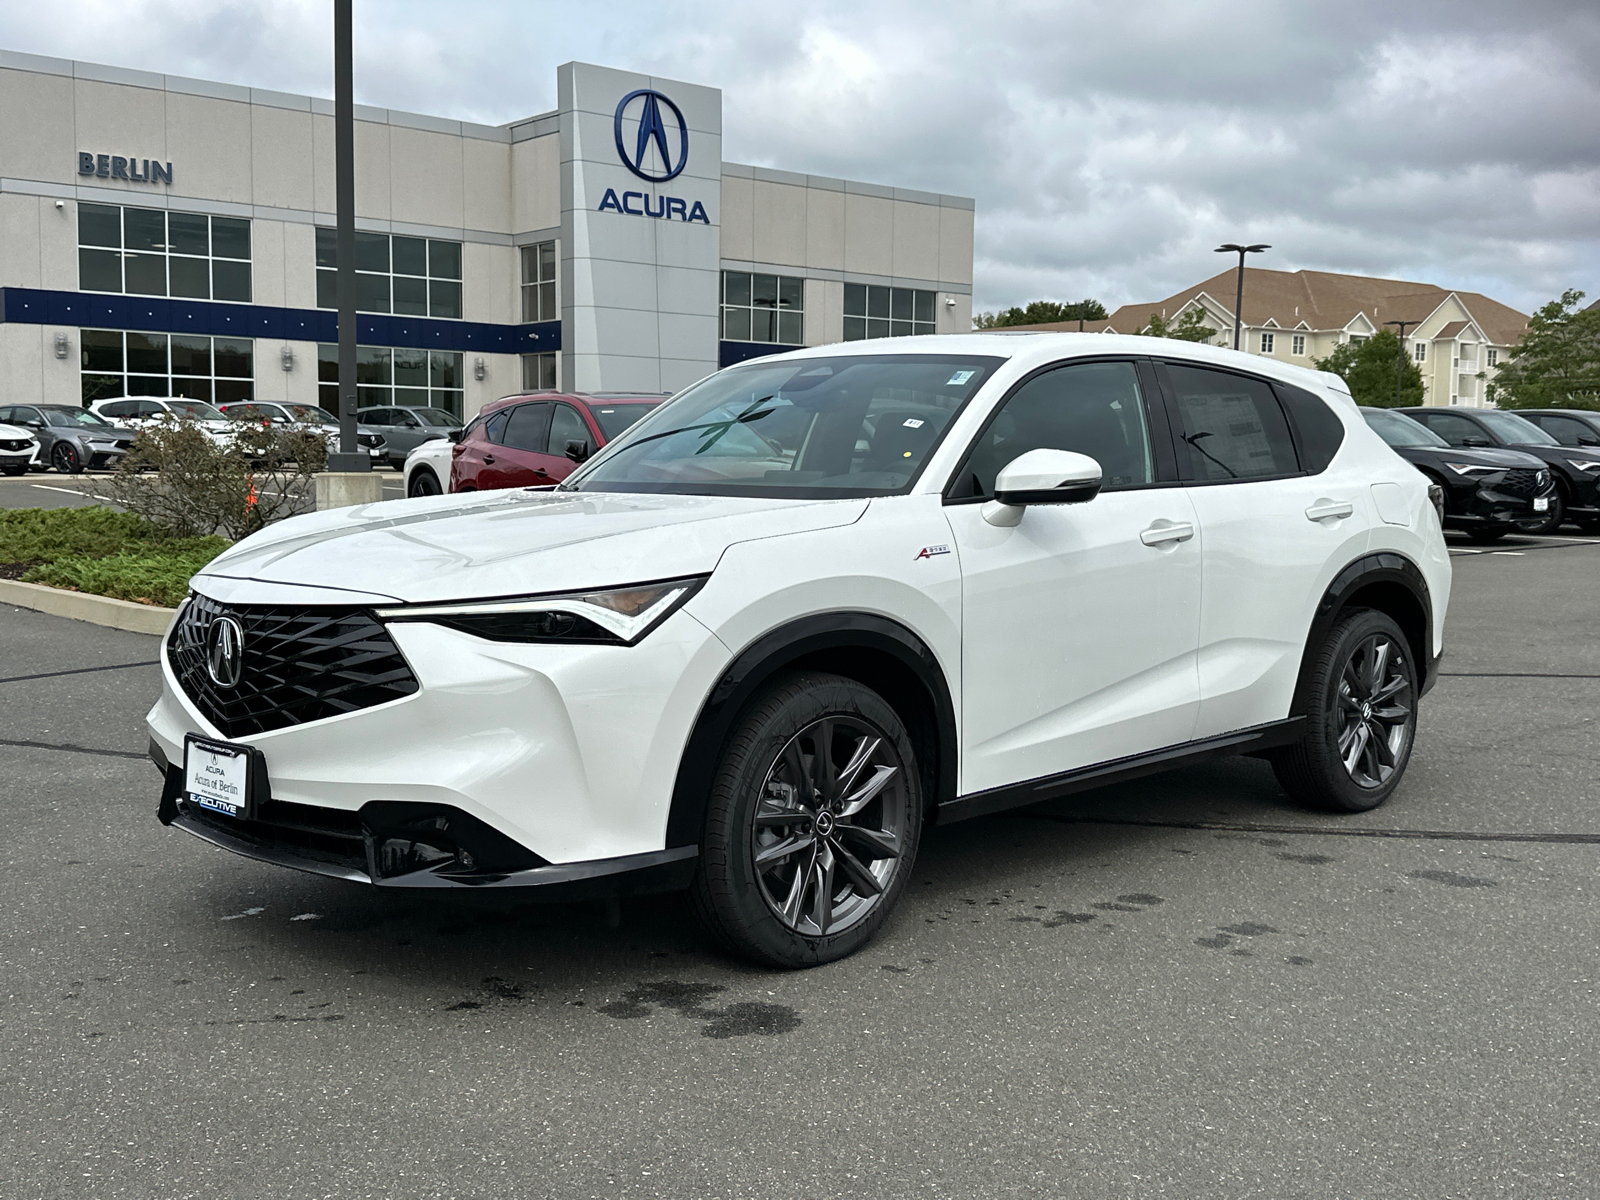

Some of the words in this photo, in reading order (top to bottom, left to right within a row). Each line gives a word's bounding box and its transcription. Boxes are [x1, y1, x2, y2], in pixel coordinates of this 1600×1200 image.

[78, 151, 172, 184] BERLIN
[598, 188, 710, 224] ACURA
[205, 765, 225, 777] ACURA
[194, 772, 210, 788] Acura
[211, 779, 218, 790] of
[219, 779, 238, 795] Berlin
[190, 793, 237, 814] EXECUTIVE
